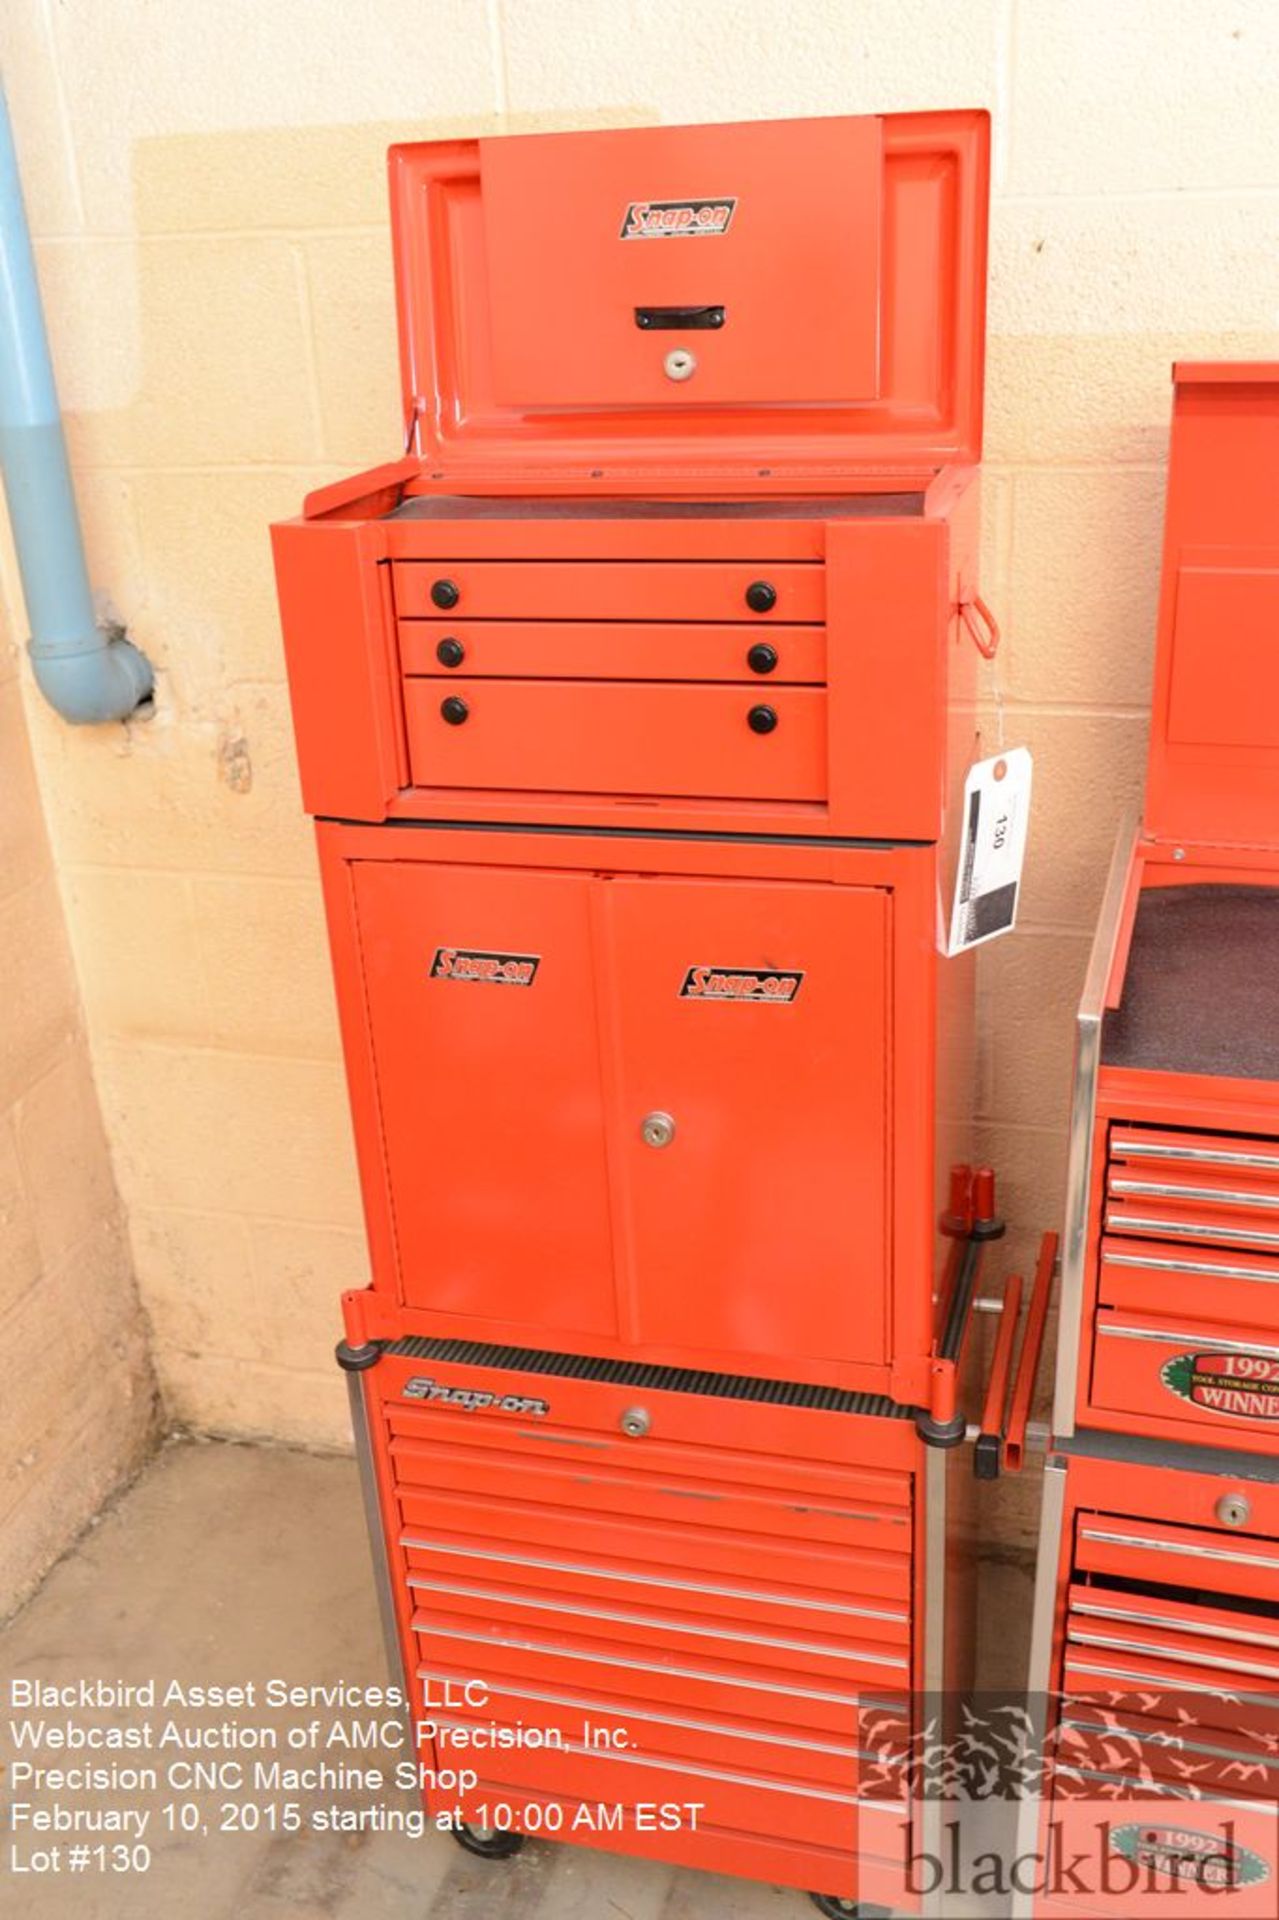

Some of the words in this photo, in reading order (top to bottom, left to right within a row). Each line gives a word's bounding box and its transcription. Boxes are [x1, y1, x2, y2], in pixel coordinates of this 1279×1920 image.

[628, 205, 731, 234] Snap-on
[993, 814, 1008, 850] 130
[437, 950, 534, 981] Snap-on
[688, 967, 797, 998] Snap-on
[403, 1377, 548, 1417] Snap-on
[1165, 1832, 1218, 1854] 1992
